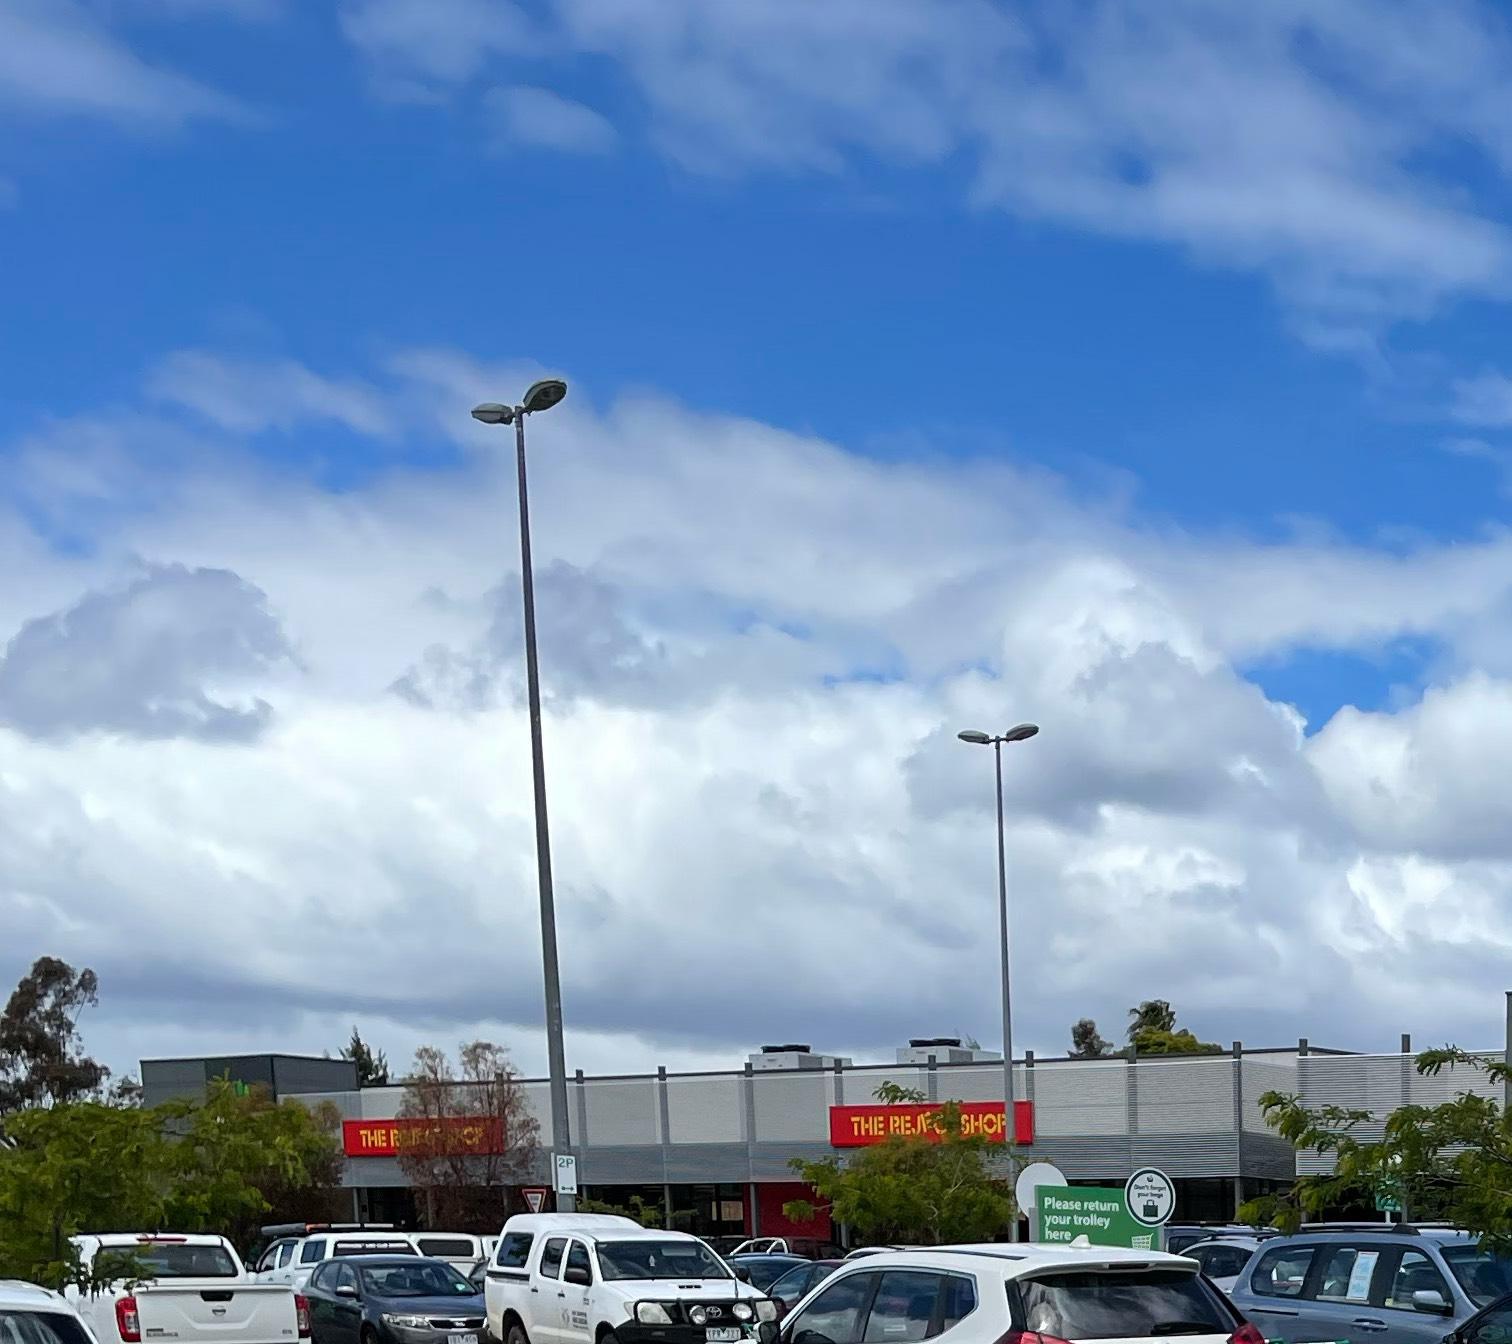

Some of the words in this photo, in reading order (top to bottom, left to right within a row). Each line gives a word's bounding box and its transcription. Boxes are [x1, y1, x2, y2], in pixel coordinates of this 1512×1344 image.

[851, 1115, 884, 1136] THE
[359, 1129, 387, 1148] THE
[558, 1157, 574, 1168] 2P
[1044, 1196, 1081, 1211] Please
[1083, 1199, 1120, 1212] return
[1044, 1214, 1071, 1226] your
[1073, 1213, 1110, 1229] trolley
[1044, 1227, 1071, 1240] here
